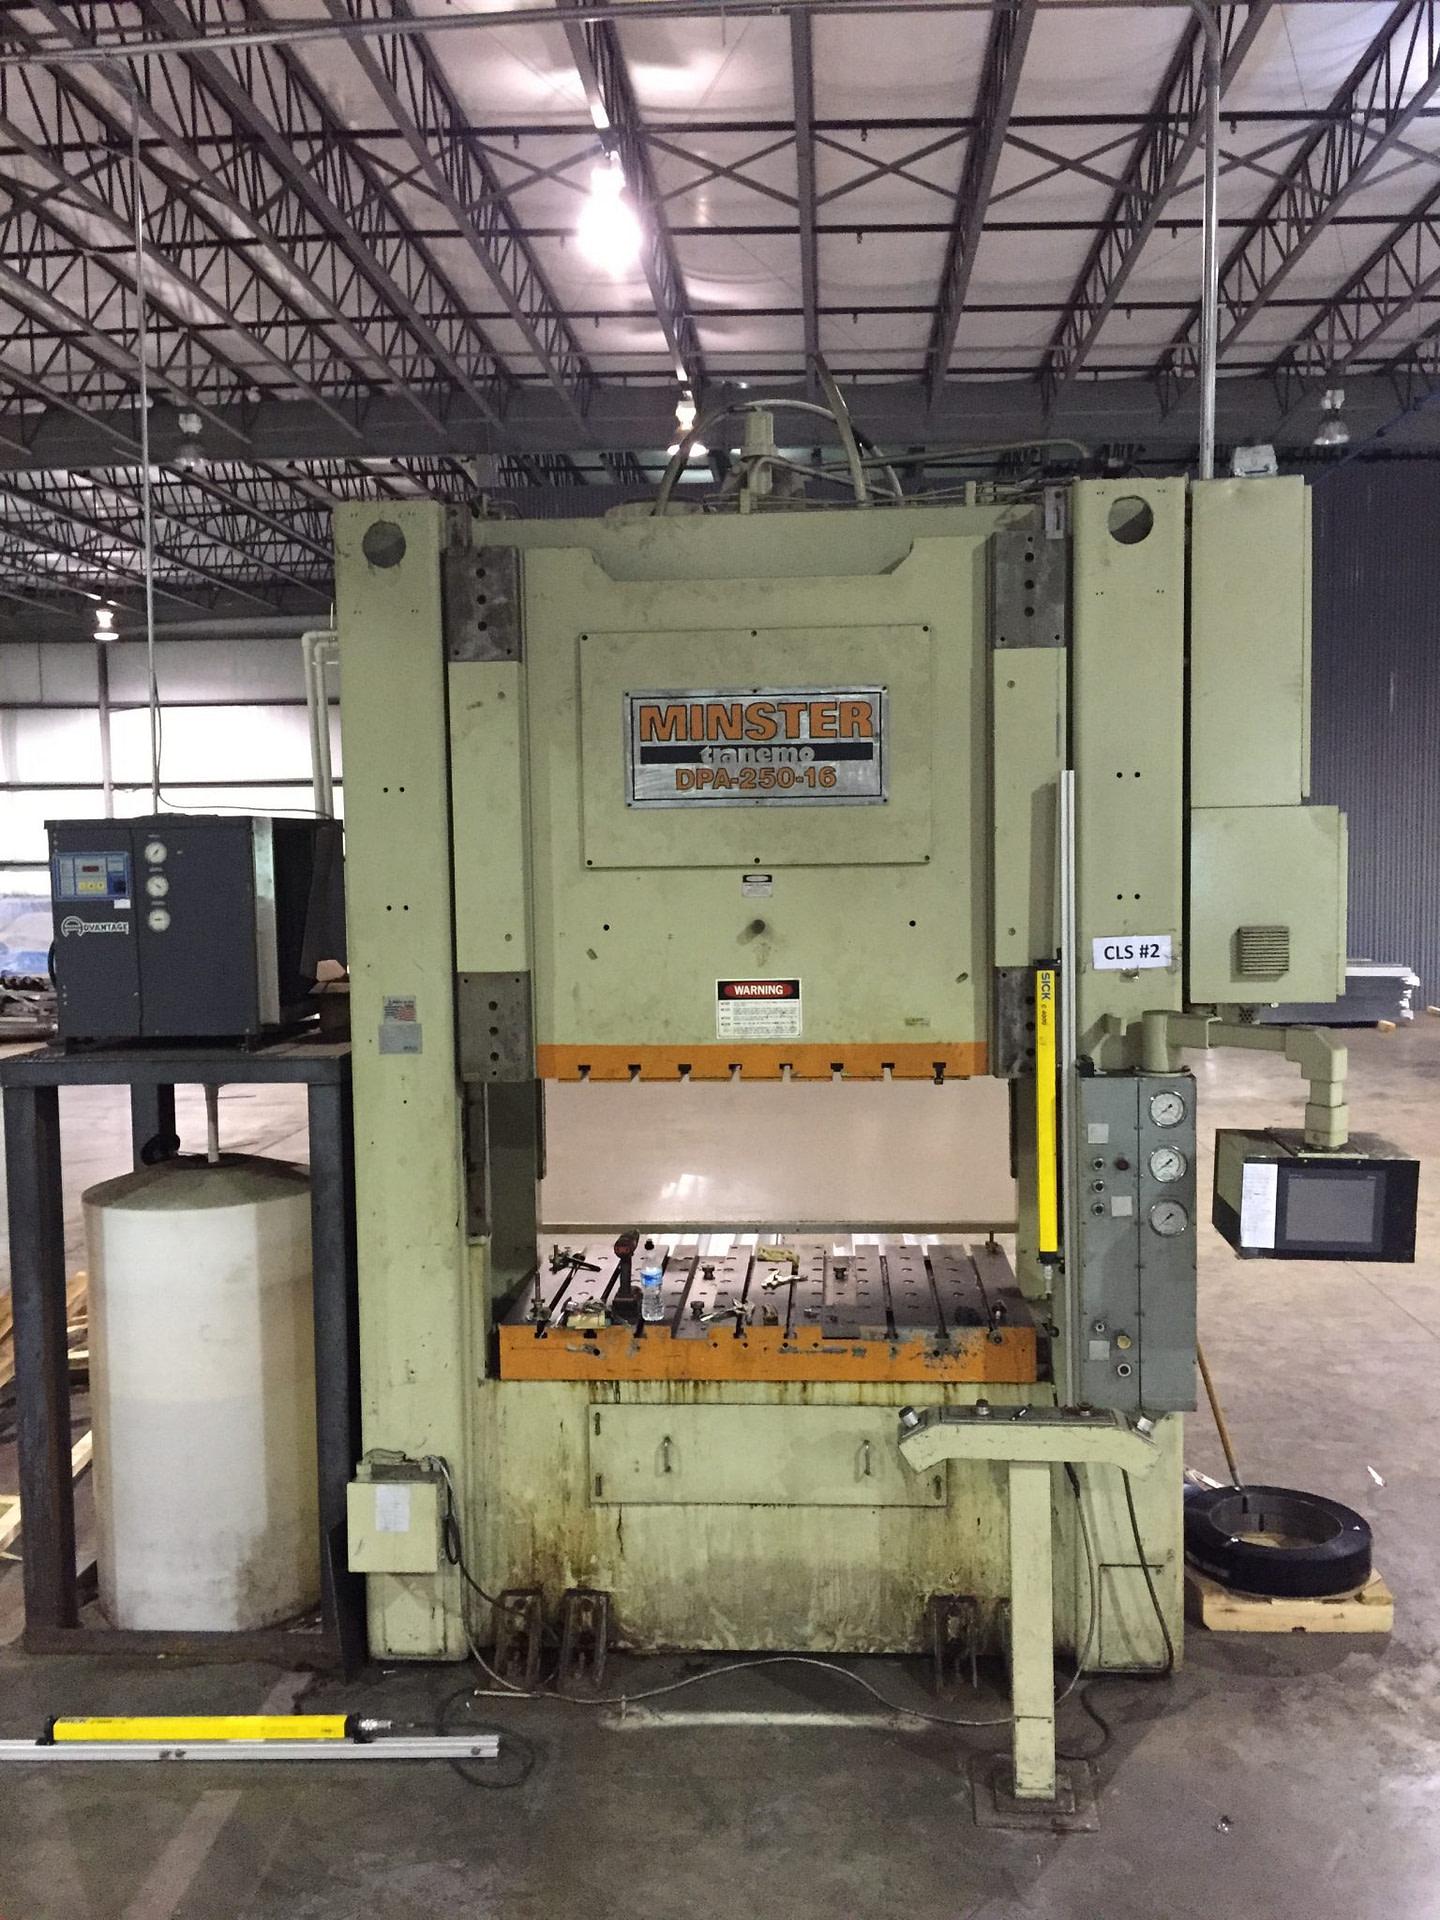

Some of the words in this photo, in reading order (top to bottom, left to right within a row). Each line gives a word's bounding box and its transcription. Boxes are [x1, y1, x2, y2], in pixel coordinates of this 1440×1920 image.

[639, 701, 874, 742] MINSTER
[675, 766, 837, 791] DPA-250-16
[1104, 944, 1134, 961] CLS
[1139, 943, 1161, 959] #2
[734, 984, 784, 996] WARNING
[1041, 972, 1051, 1001] SICK
